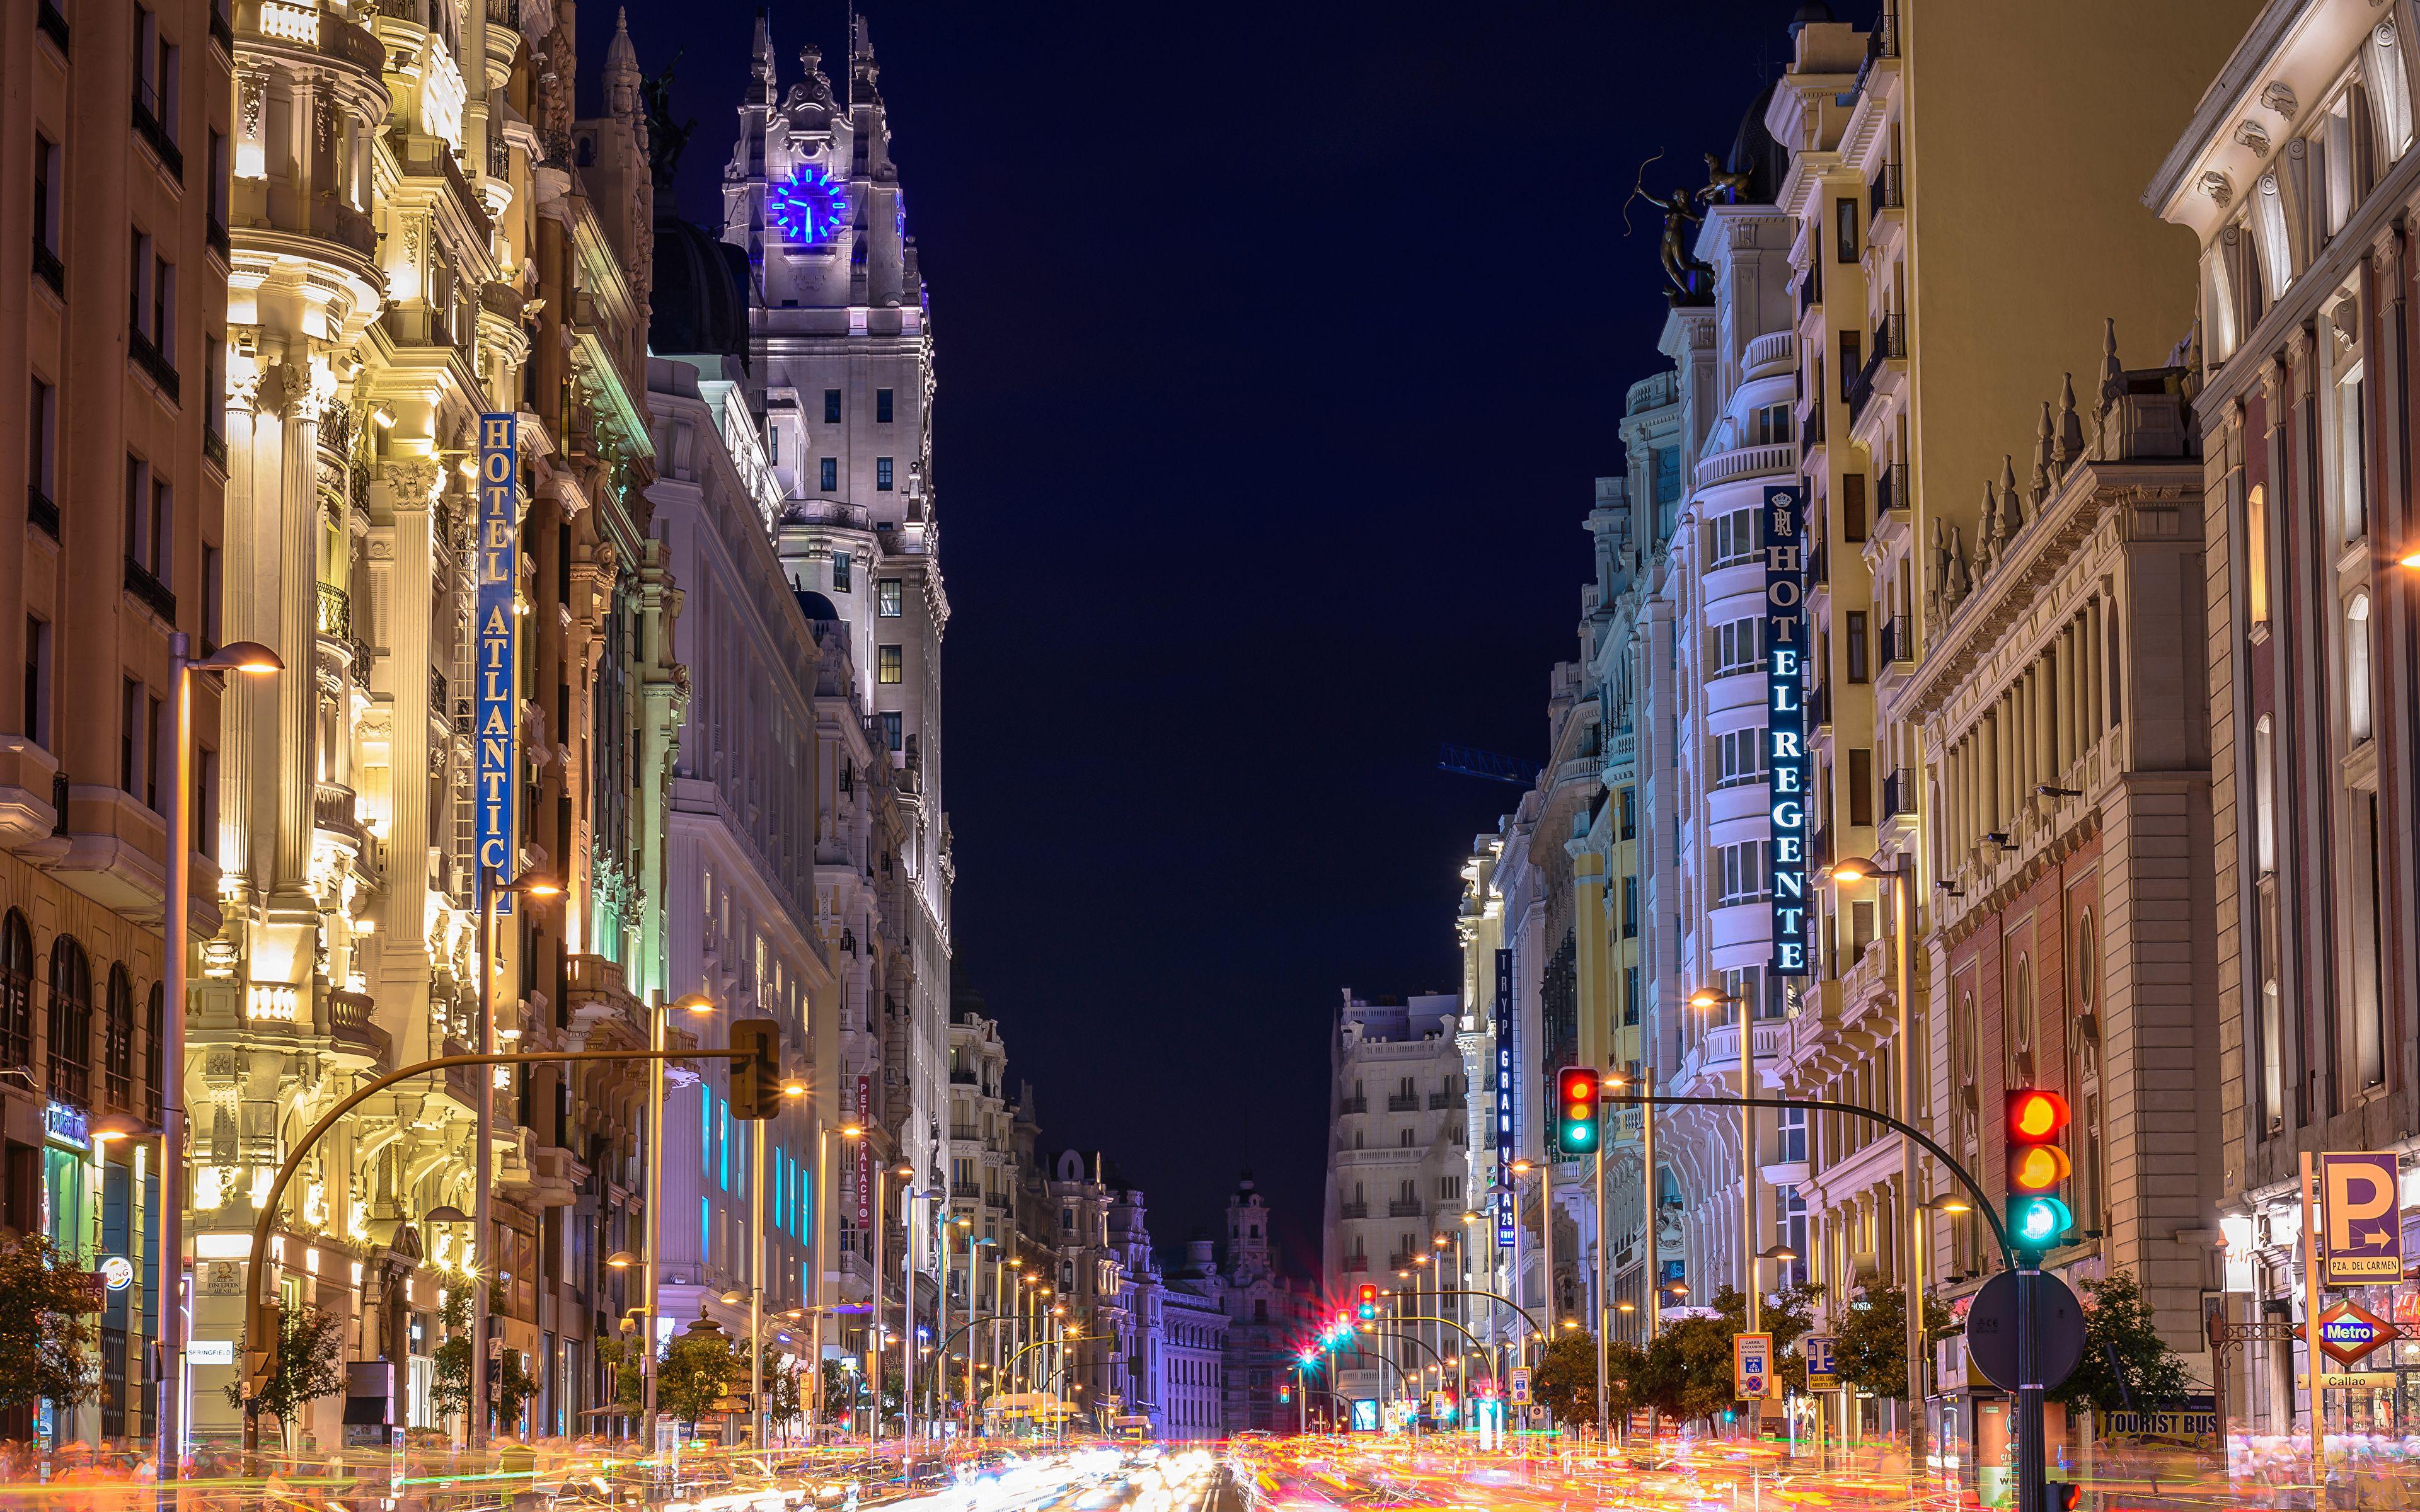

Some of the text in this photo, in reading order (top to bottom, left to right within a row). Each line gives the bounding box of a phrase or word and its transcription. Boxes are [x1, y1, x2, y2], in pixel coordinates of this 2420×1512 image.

[484, 420, 511, 585] HOTEL
[1766, 546, 1804, 968] HOTEL REGENTE
[1501, 1050, 1509, 1131] GRAN
[52, 1111, 74, 1137] BURGER
[2327, 1163, 2394, 1251] P
[1502, 1212, 1512, 1225] 25
[2332, 1261, 2397, 1271] PZA. DEL CARMEN
[2327, 1325, 2370, 1339] Metro
[884, 1355, 924, 1365] Estean
[2329, 1377, 2366, 1386] Callao
[2104, 1414, 2216, 1433] TOURIST BUS
